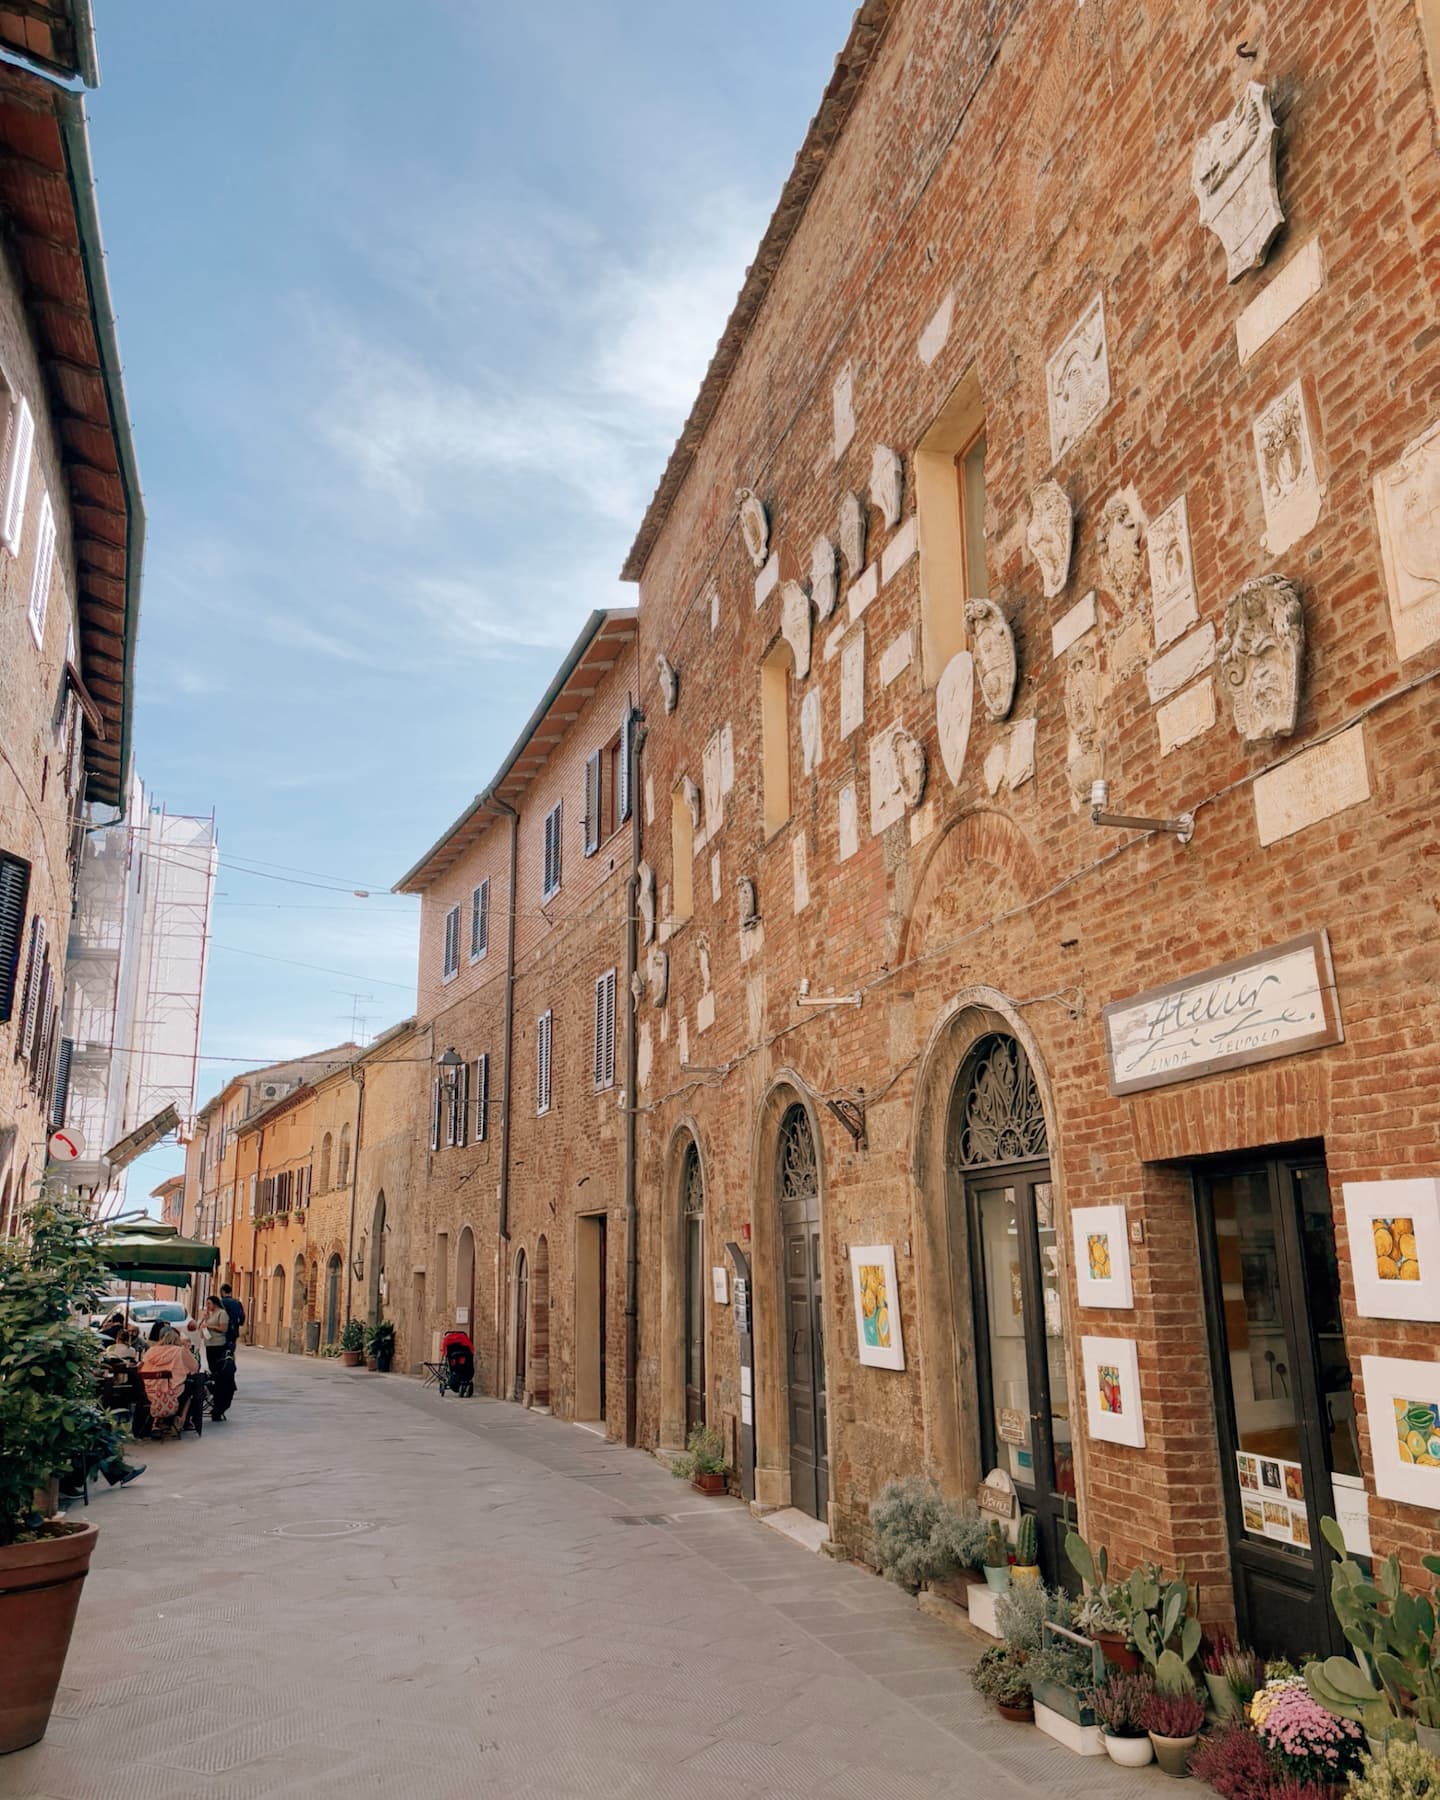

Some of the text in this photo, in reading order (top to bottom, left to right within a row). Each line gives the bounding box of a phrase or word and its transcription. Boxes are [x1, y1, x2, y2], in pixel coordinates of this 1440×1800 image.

[1147, 975, 1281, 1040] Atelier
[1149, 1028, 1280, 1073] LINDA LEUPOLD
